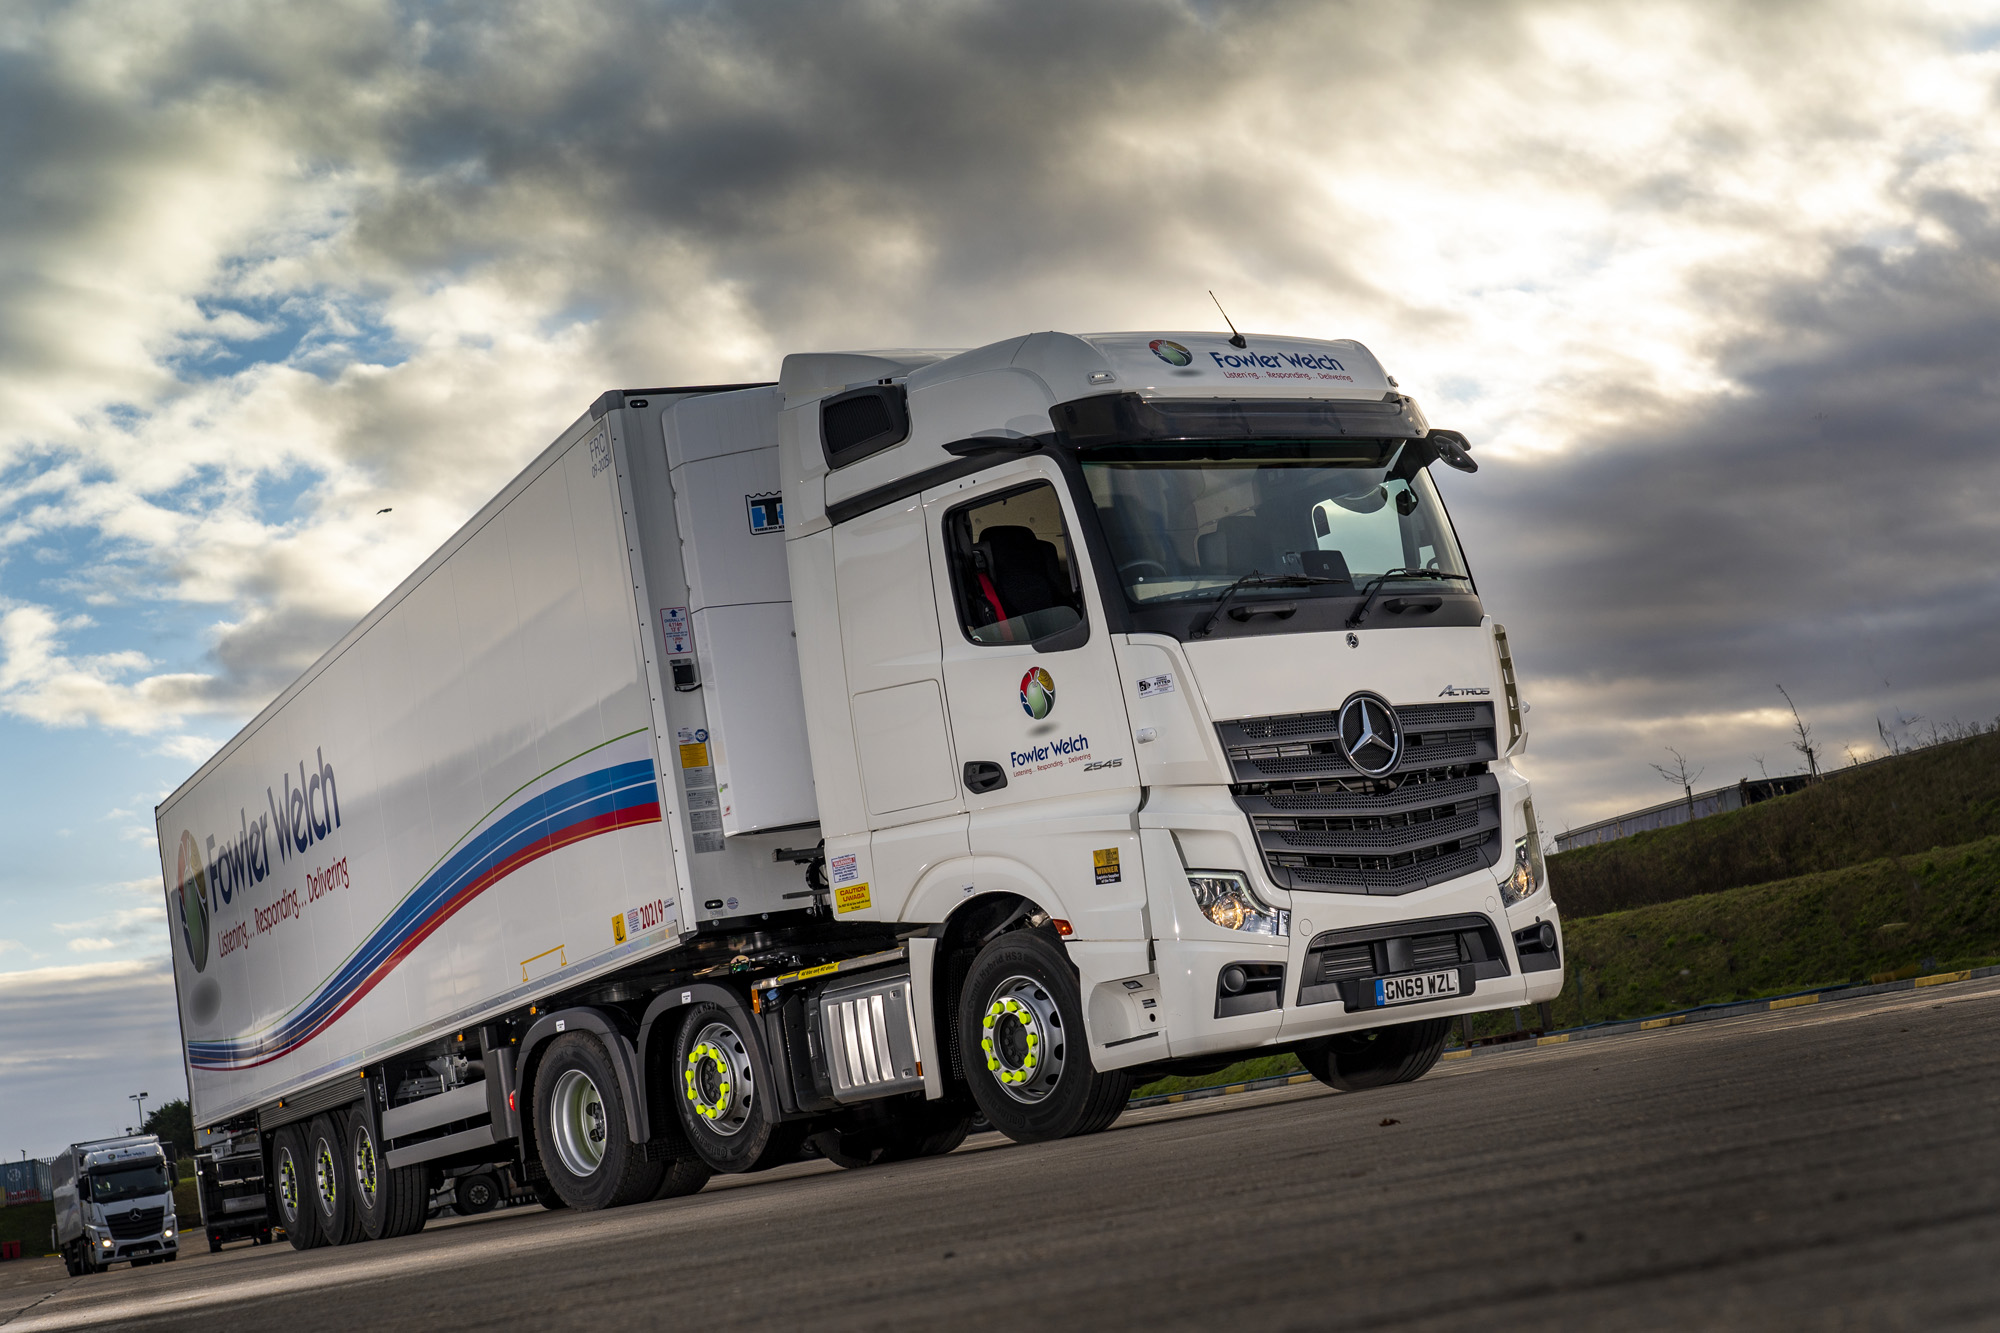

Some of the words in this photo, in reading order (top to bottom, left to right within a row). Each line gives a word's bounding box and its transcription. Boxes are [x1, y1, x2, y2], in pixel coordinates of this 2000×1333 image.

[1209, 351, 1281, 369] Fowler
[1280, 353, 1345, 372] Welch
[1317, 372, 1354, 382] Delivering
[589, 433, 605, 462] FRC
[1010, 745, 1050, 768] Fowler
[1050, 734, 1089, 756] Welch
[1068, 752, 1092, 764] Delivering
[1083, 758, 1123, 772] 2545
[206, 807, 271, 914] Fowler
[267, 745, 341, 867] Welch
[306, 856, 350, 904] Delivering
[1096, 866, 1118, 875] WINNER
[840, 885, 866, 896] CAUTION
[842, 893, 865, 902] UWAGA
[639, 899, 663, 930] 20219
[979, 955, 1004, 979] Hybrid
[1005, 952, 1023, 961] HS3
[1385, 977, 1424, 1000] GN69
[1427, 973, 1455, 994] WZL
